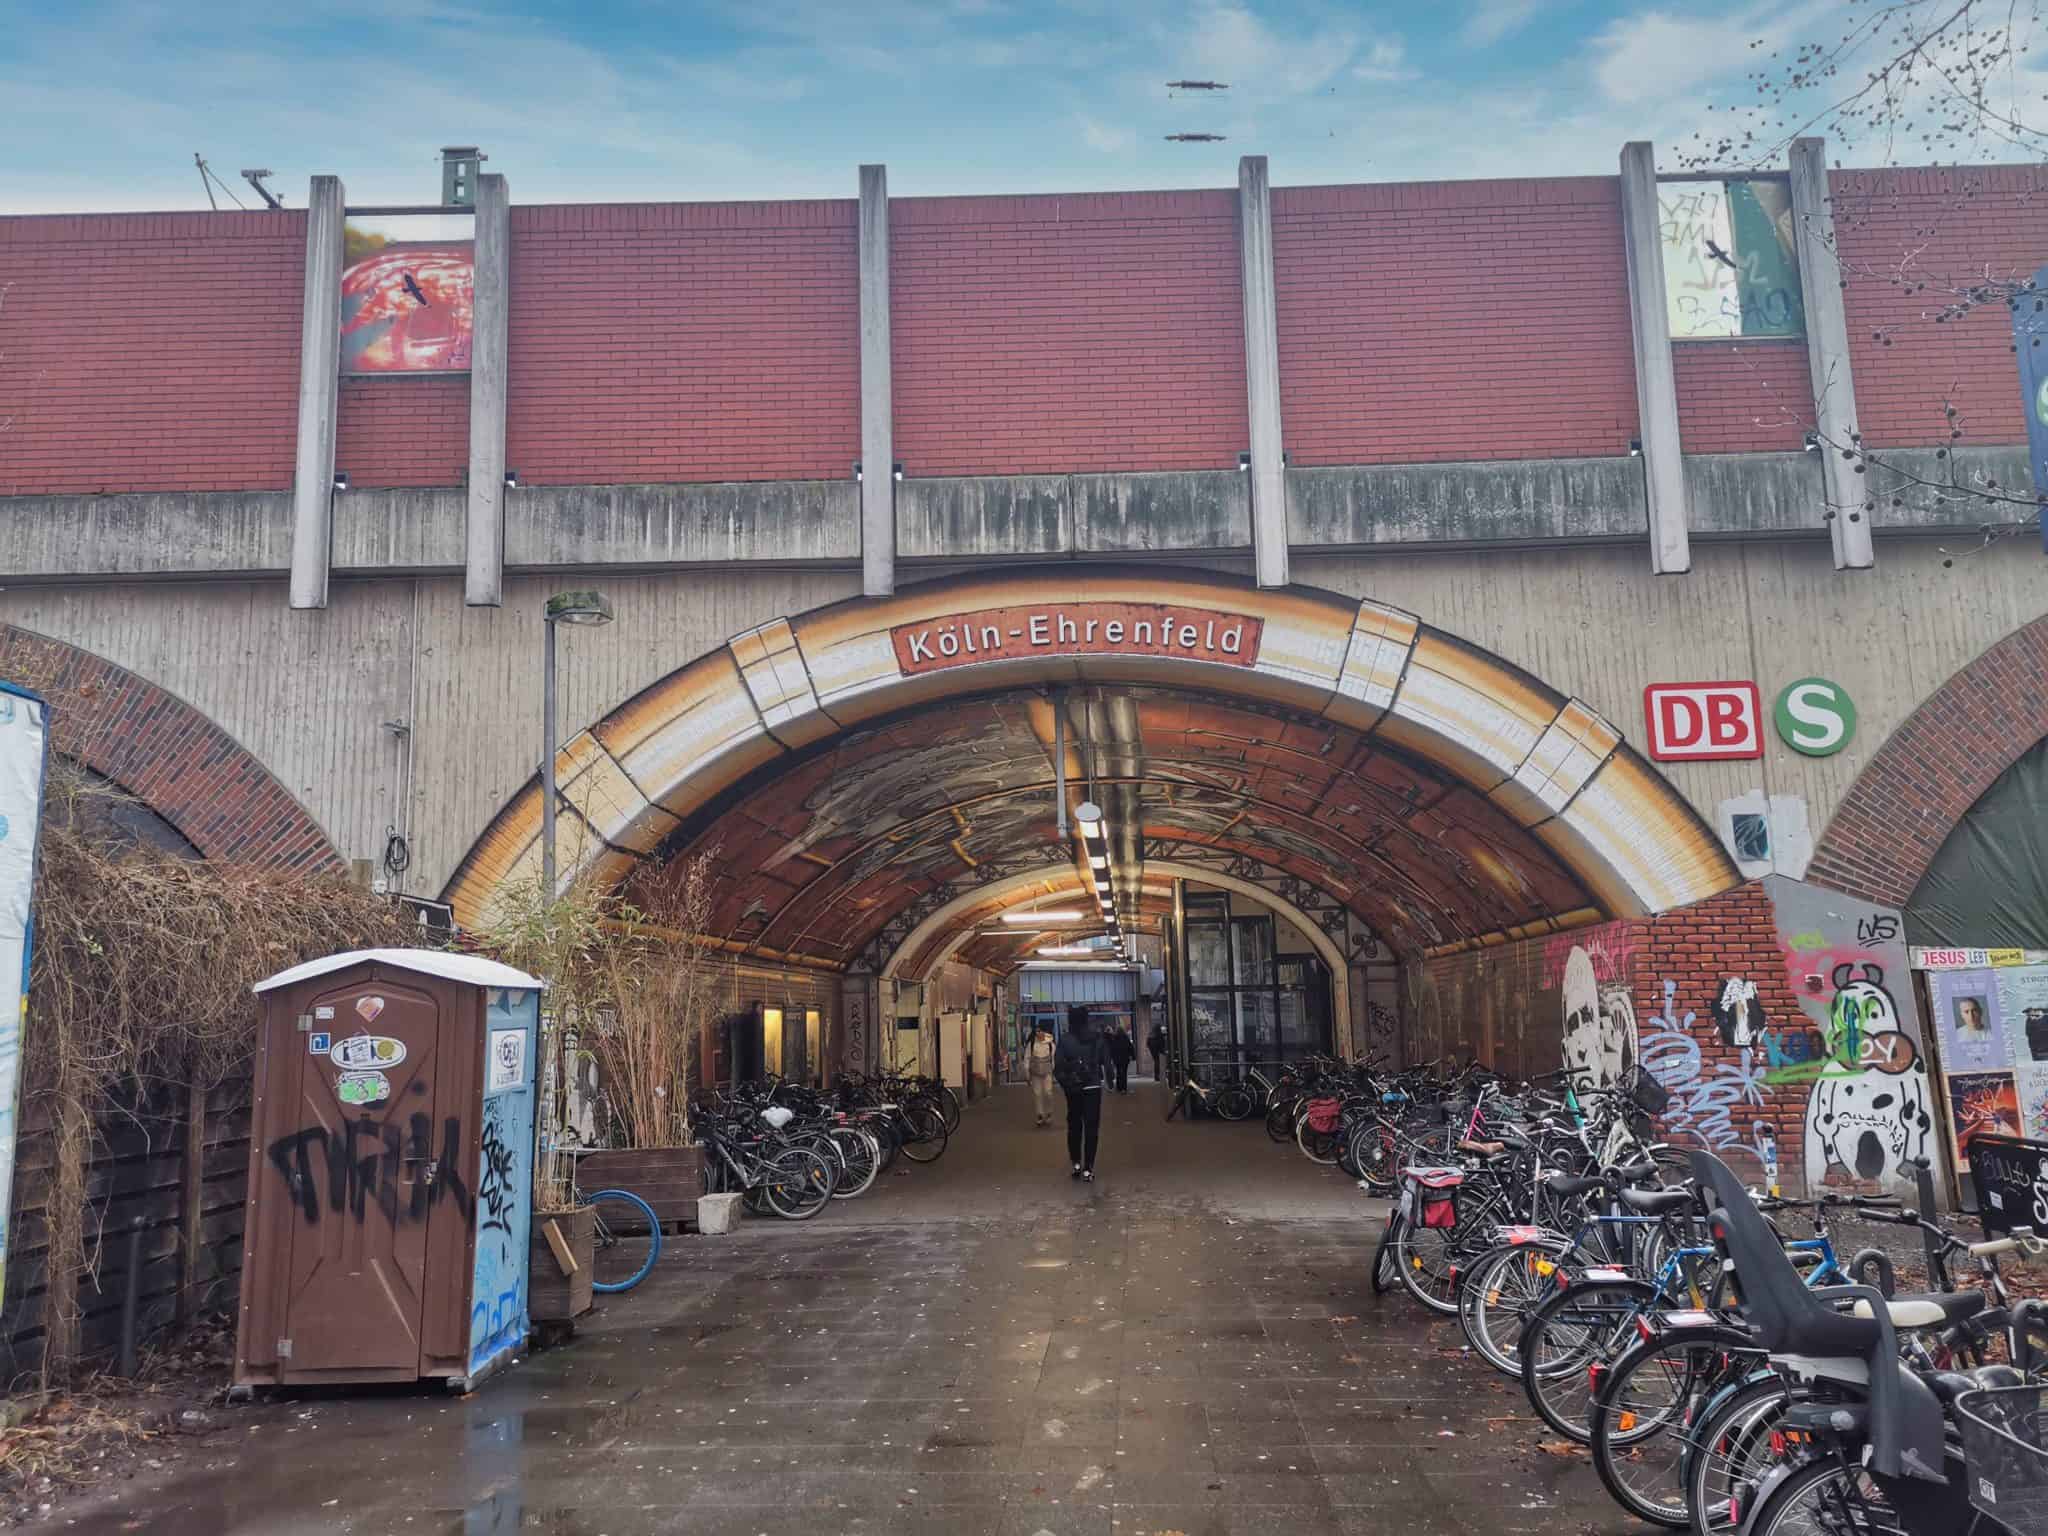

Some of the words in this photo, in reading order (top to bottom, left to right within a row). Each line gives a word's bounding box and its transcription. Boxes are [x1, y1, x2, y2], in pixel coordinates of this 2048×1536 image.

[908, 614, 1243, 662] Köln-Ehrenfeld
[1659, 693, 1750, 748] DB
[1786, 683, 1845, 749] S
[1924, 951, 1967, 966] JESUS
